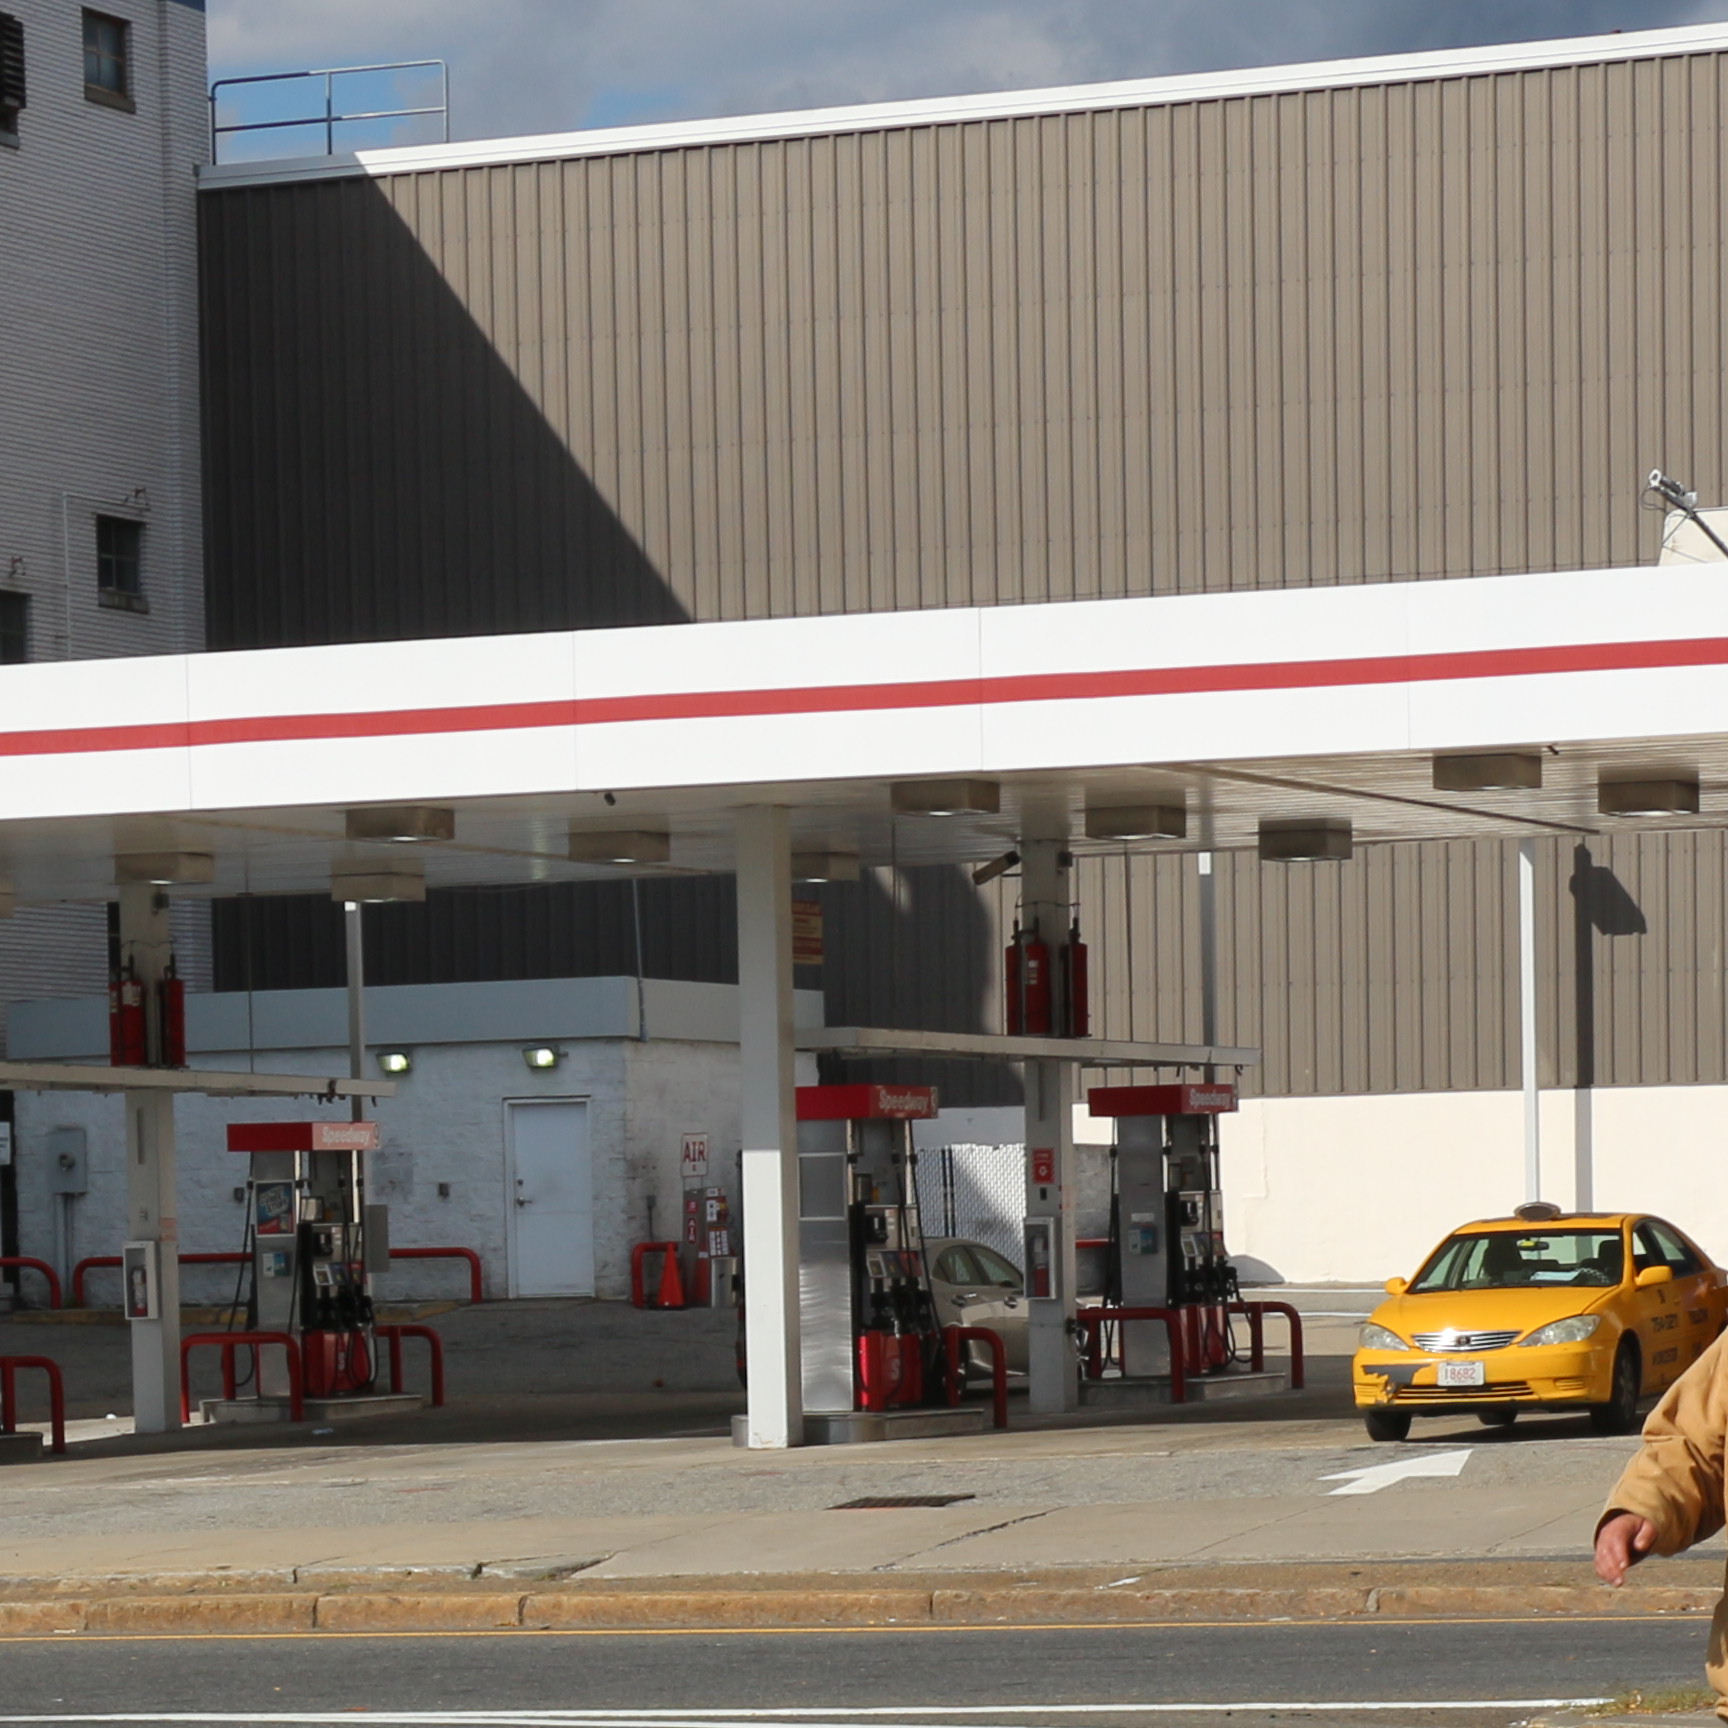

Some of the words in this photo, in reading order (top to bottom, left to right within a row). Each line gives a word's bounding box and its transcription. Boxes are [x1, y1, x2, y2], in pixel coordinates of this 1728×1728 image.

[879, 1089, 928, 1115] Speedway
[1190, 1088, 1231, 1110] Speedway
[321, 1126, 370, 1145] Speedway
[683, 1142, 706, 1162] AIR
